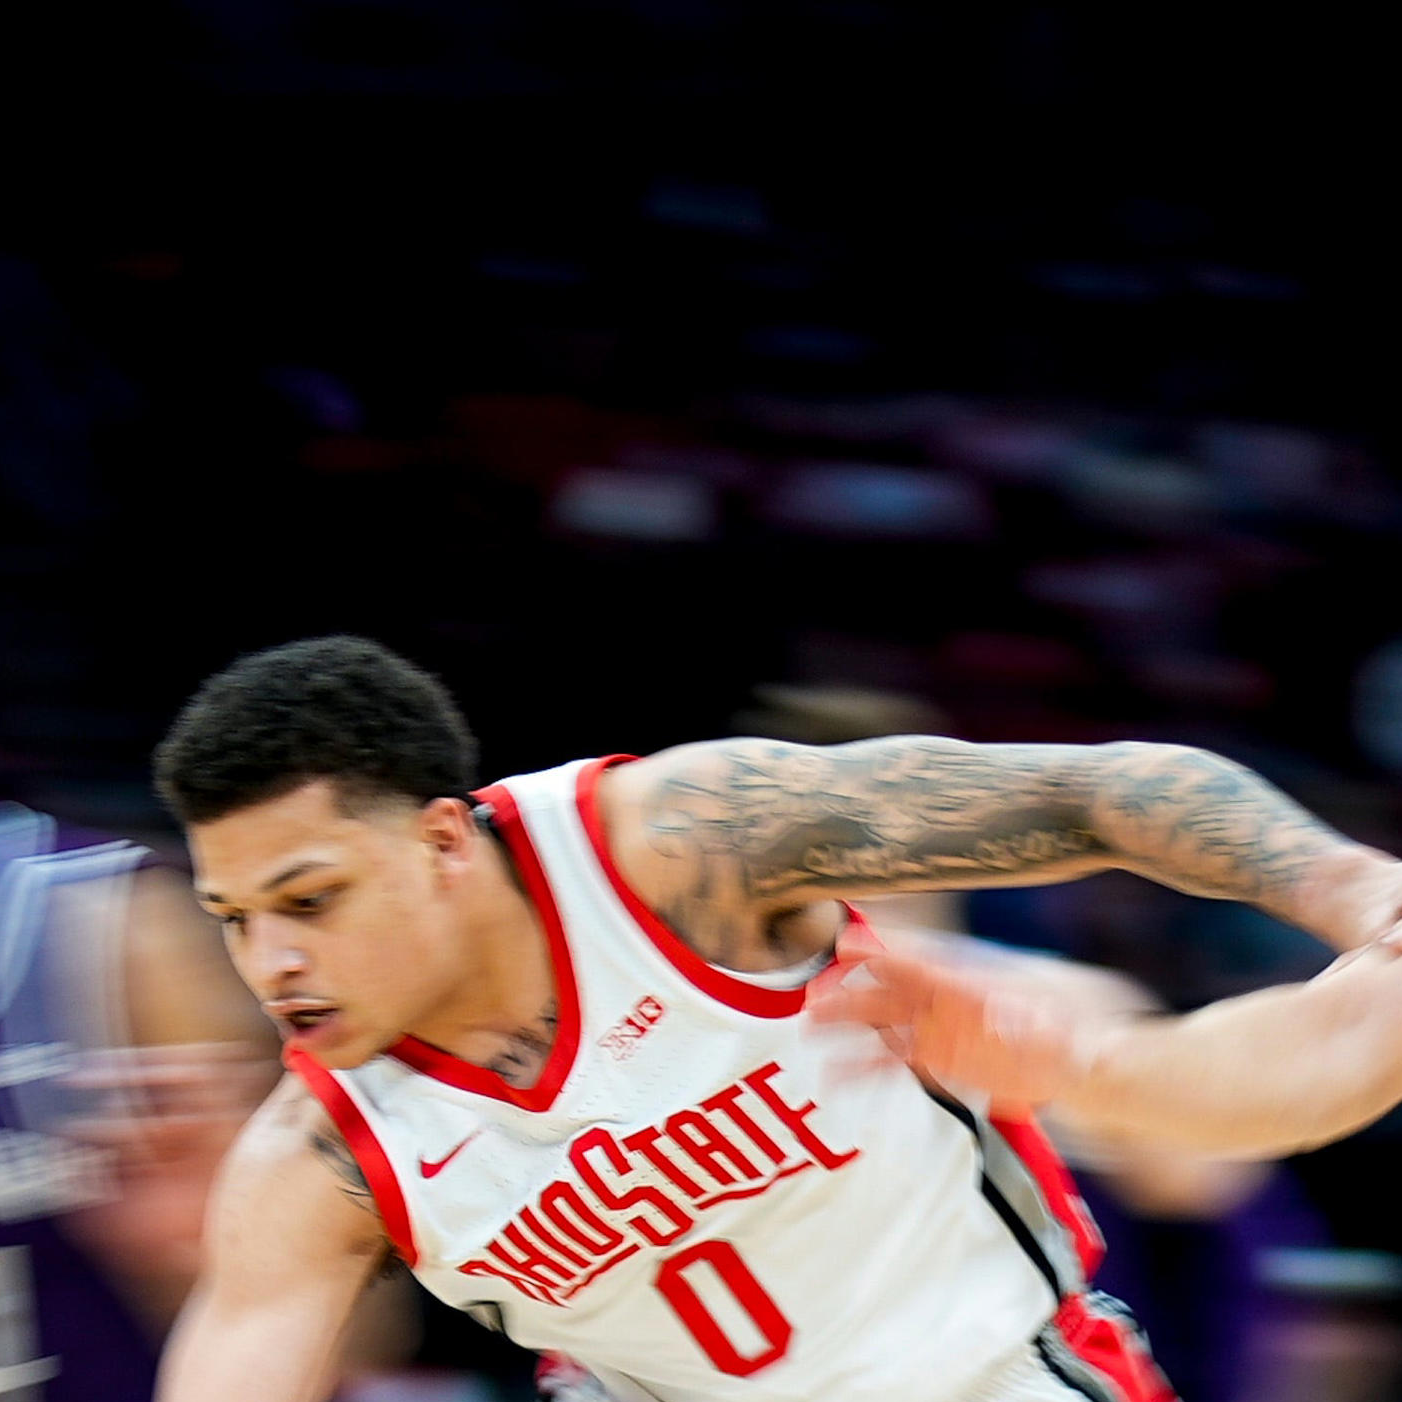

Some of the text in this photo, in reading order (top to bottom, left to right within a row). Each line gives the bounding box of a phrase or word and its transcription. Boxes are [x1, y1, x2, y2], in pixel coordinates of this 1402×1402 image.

[457, 1061, 863, 1308] OHIO STATE
[654, 1239, 793, 1378] 0
